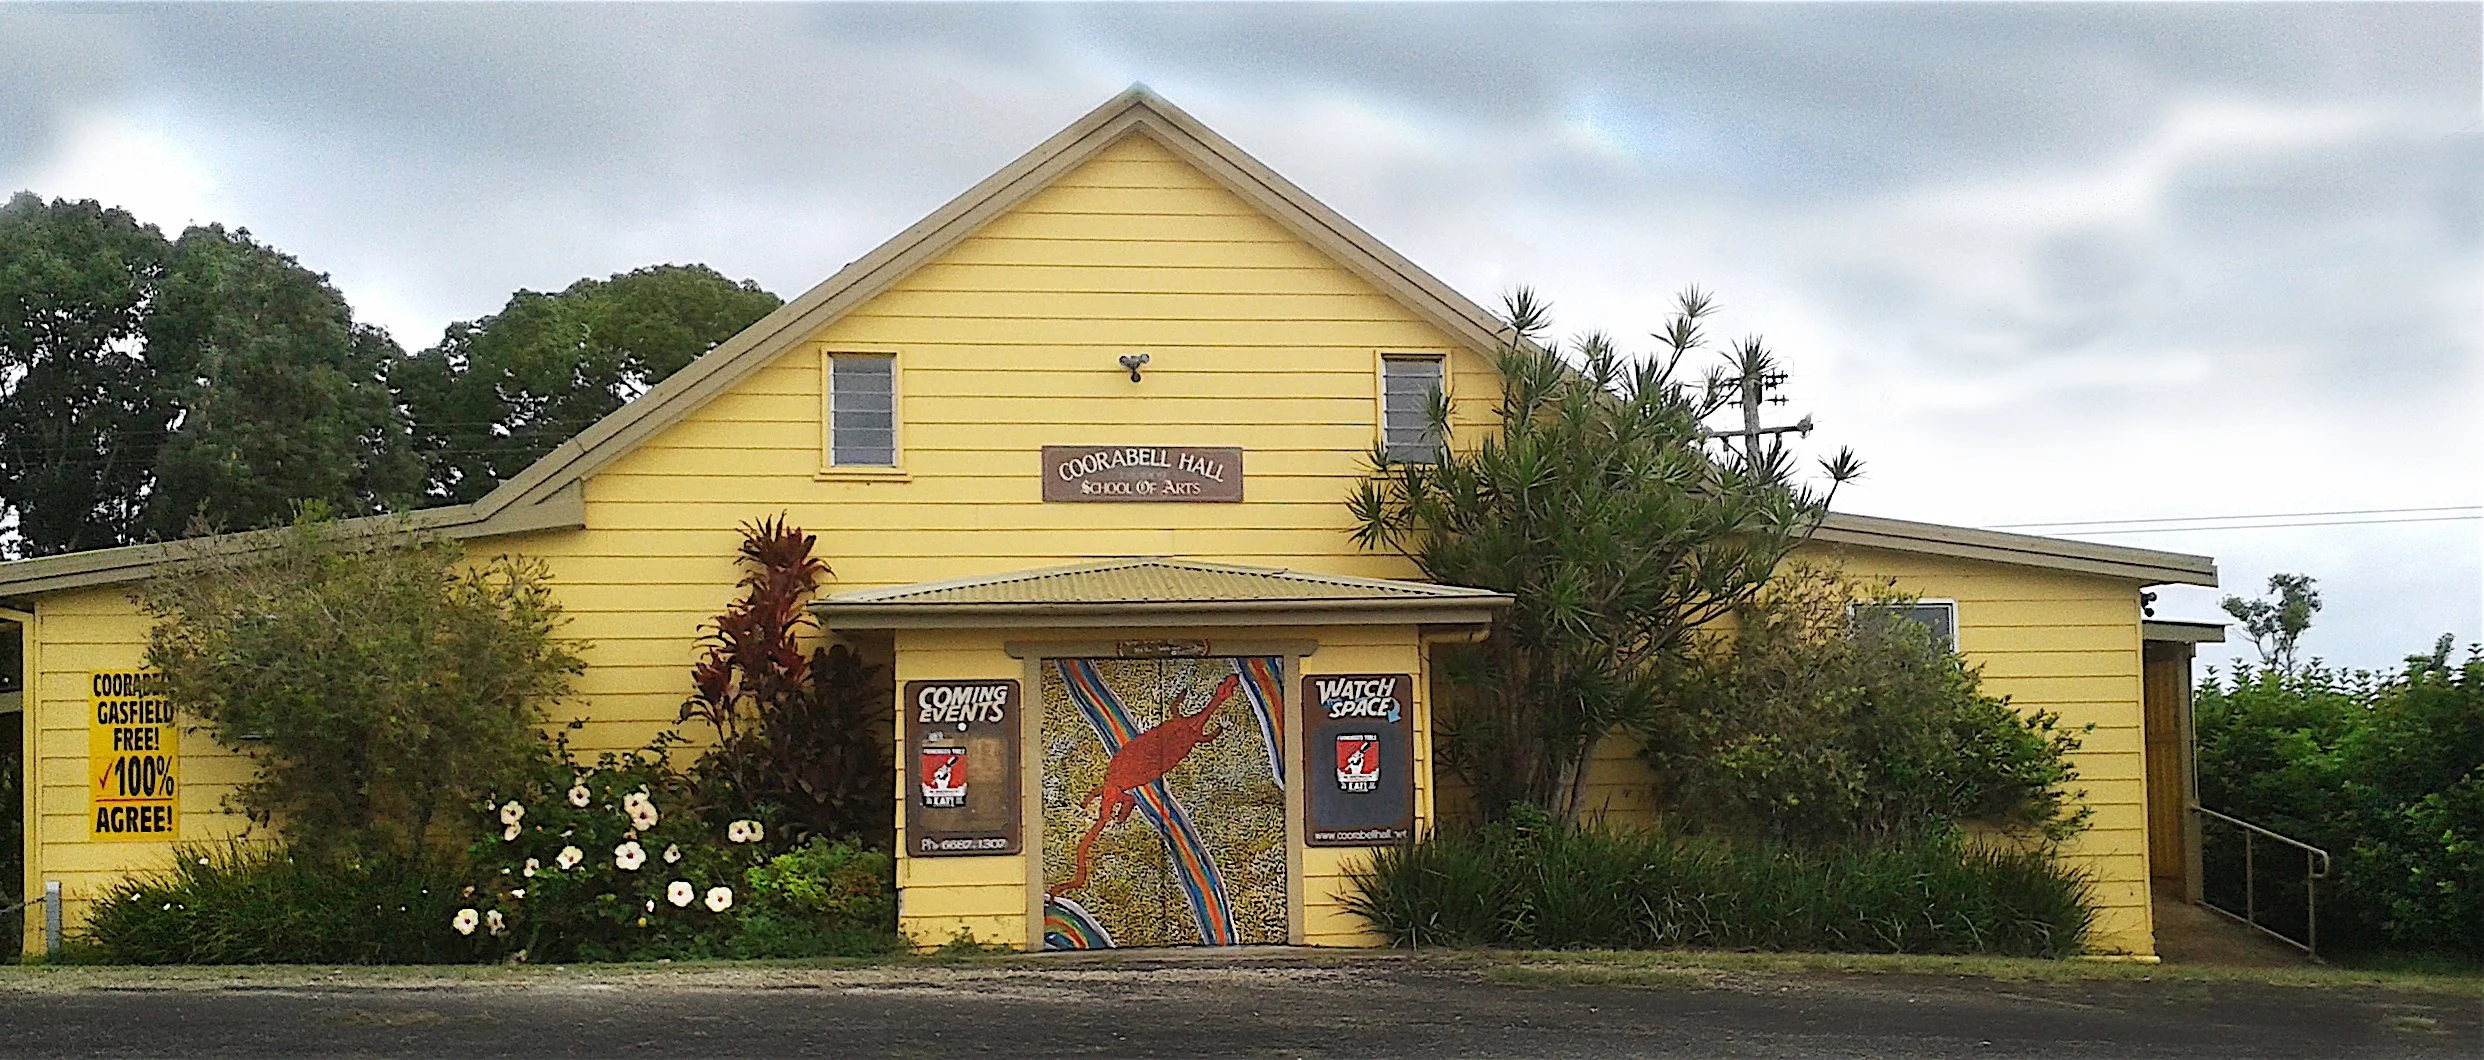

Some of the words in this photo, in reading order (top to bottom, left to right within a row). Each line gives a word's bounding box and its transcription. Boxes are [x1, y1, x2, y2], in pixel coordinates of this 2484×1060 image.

[1058, 448, 1171, 481] COORABELL
[1178, 453, 1224, 483] HALL
[1161, 479, 1201, 495] ARTS
[919, 685, 1008, 710] COMING
[1316, 677, 1396, 705] WATCH
[97, 700, 175, 725] GASFIELD
[919, 701, 1004, 723] EVENTS
[1328, 696, 1392, 718] SPACE
[113, 727, 160, 751] FREE!
[114, 755, 175, 797] 100%
[95, 805, 173, 833] AGREE!
